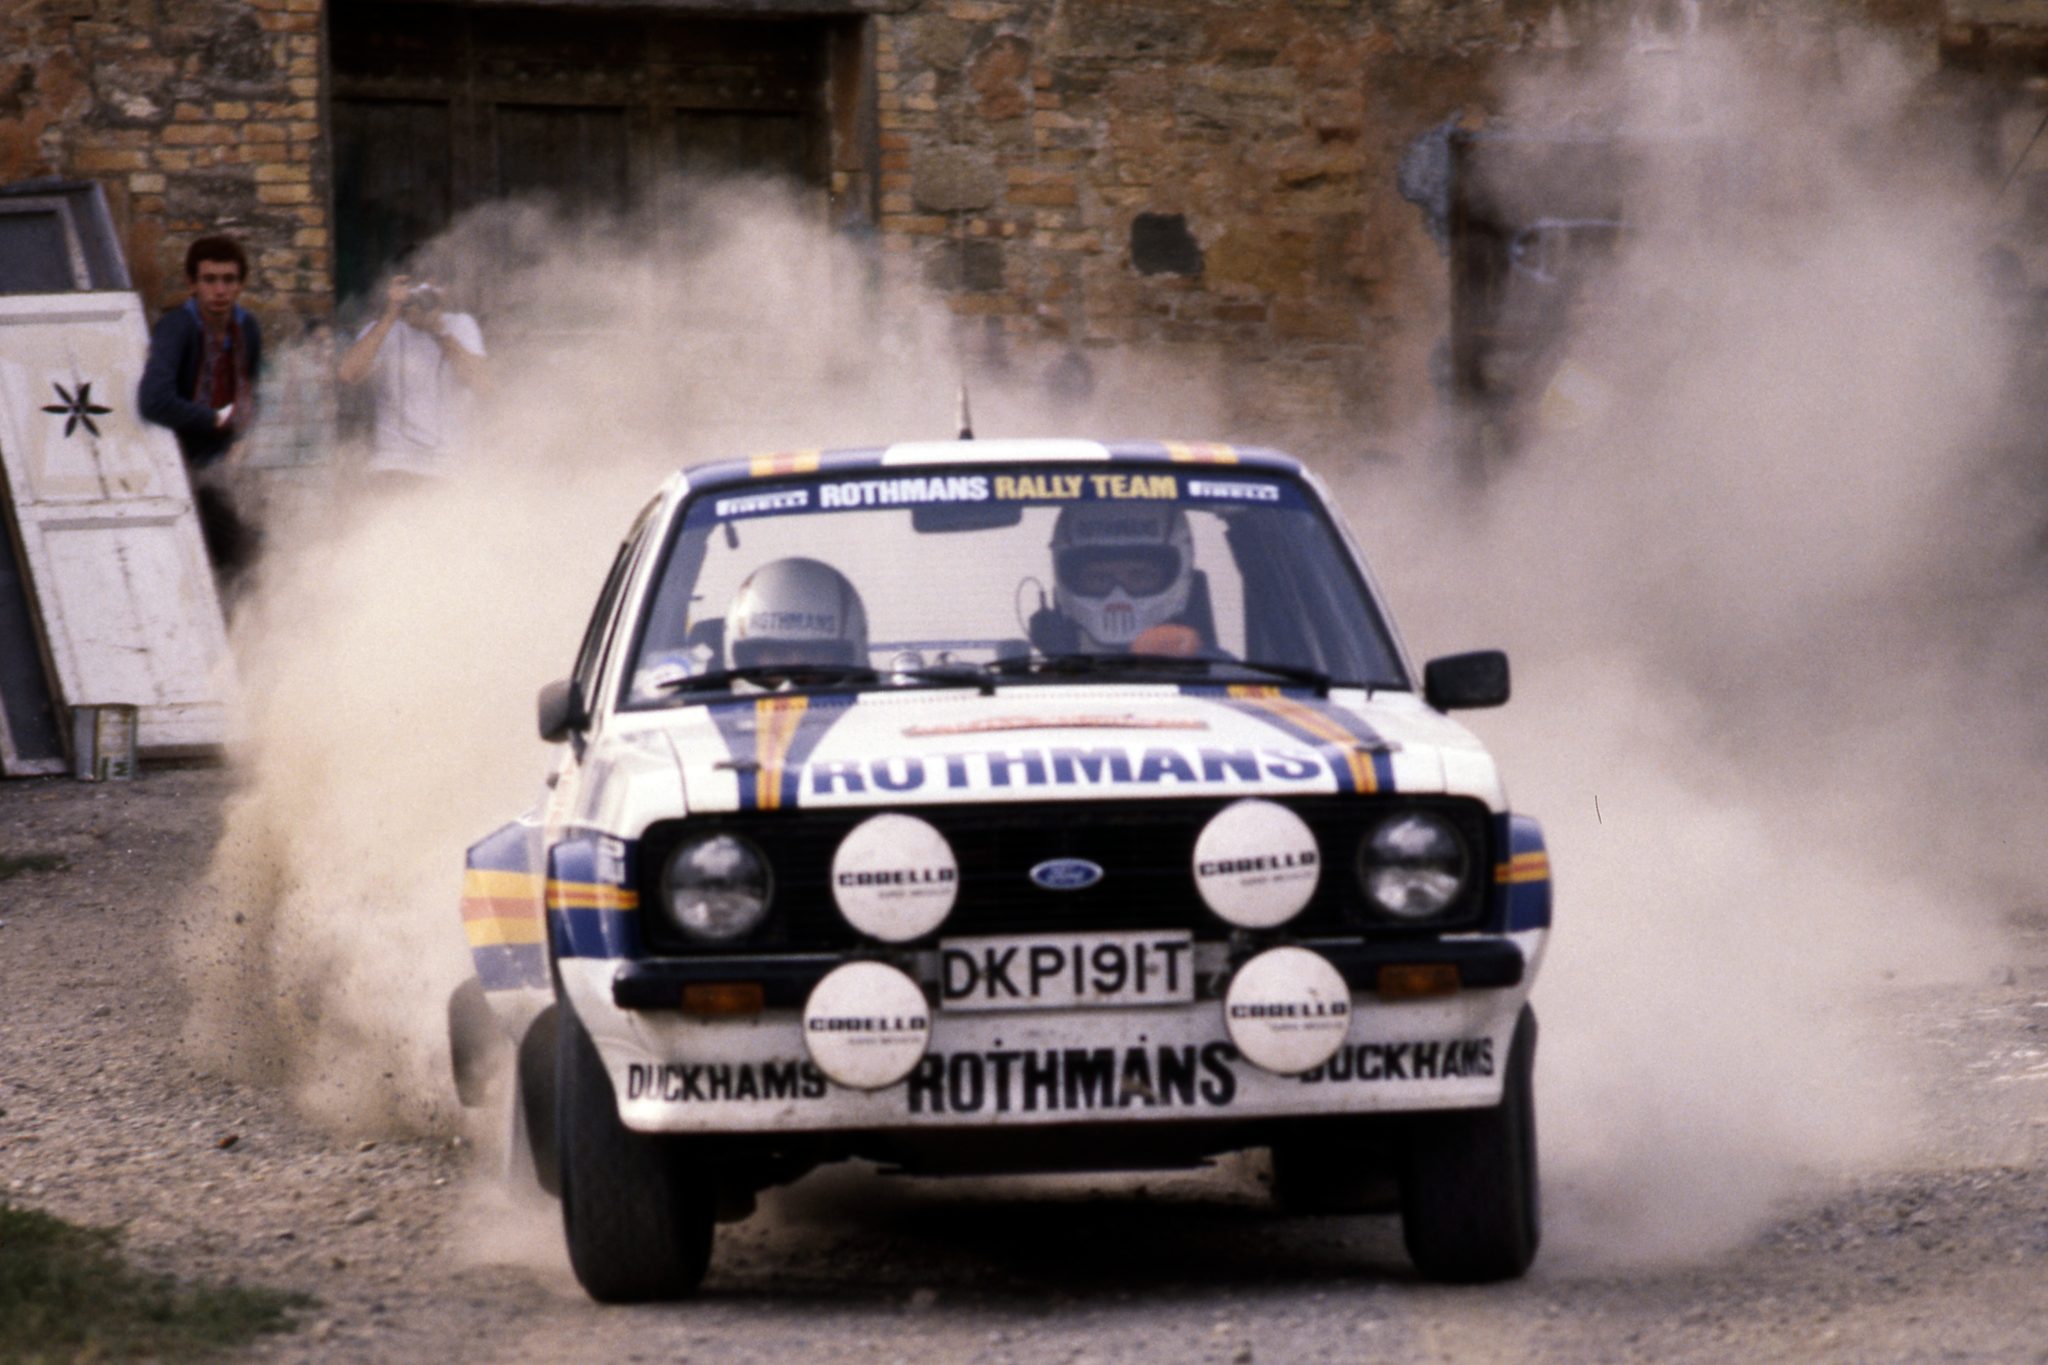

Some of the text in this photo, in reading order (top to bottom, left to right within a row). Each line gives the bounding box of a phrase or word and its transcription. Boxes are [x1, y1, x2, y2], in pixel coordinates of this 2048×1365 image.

[819, 475, 1179, 508] ROTHMANS RALLY TEAM
[810, 745, 1321, 796] ROTHMANS
[943, 941, 1191, 1000] DKP191T
[628, 1061, 827, 1101] DUCKHAMS
[907, 1041, 1241, 1114] ROTHMANS
